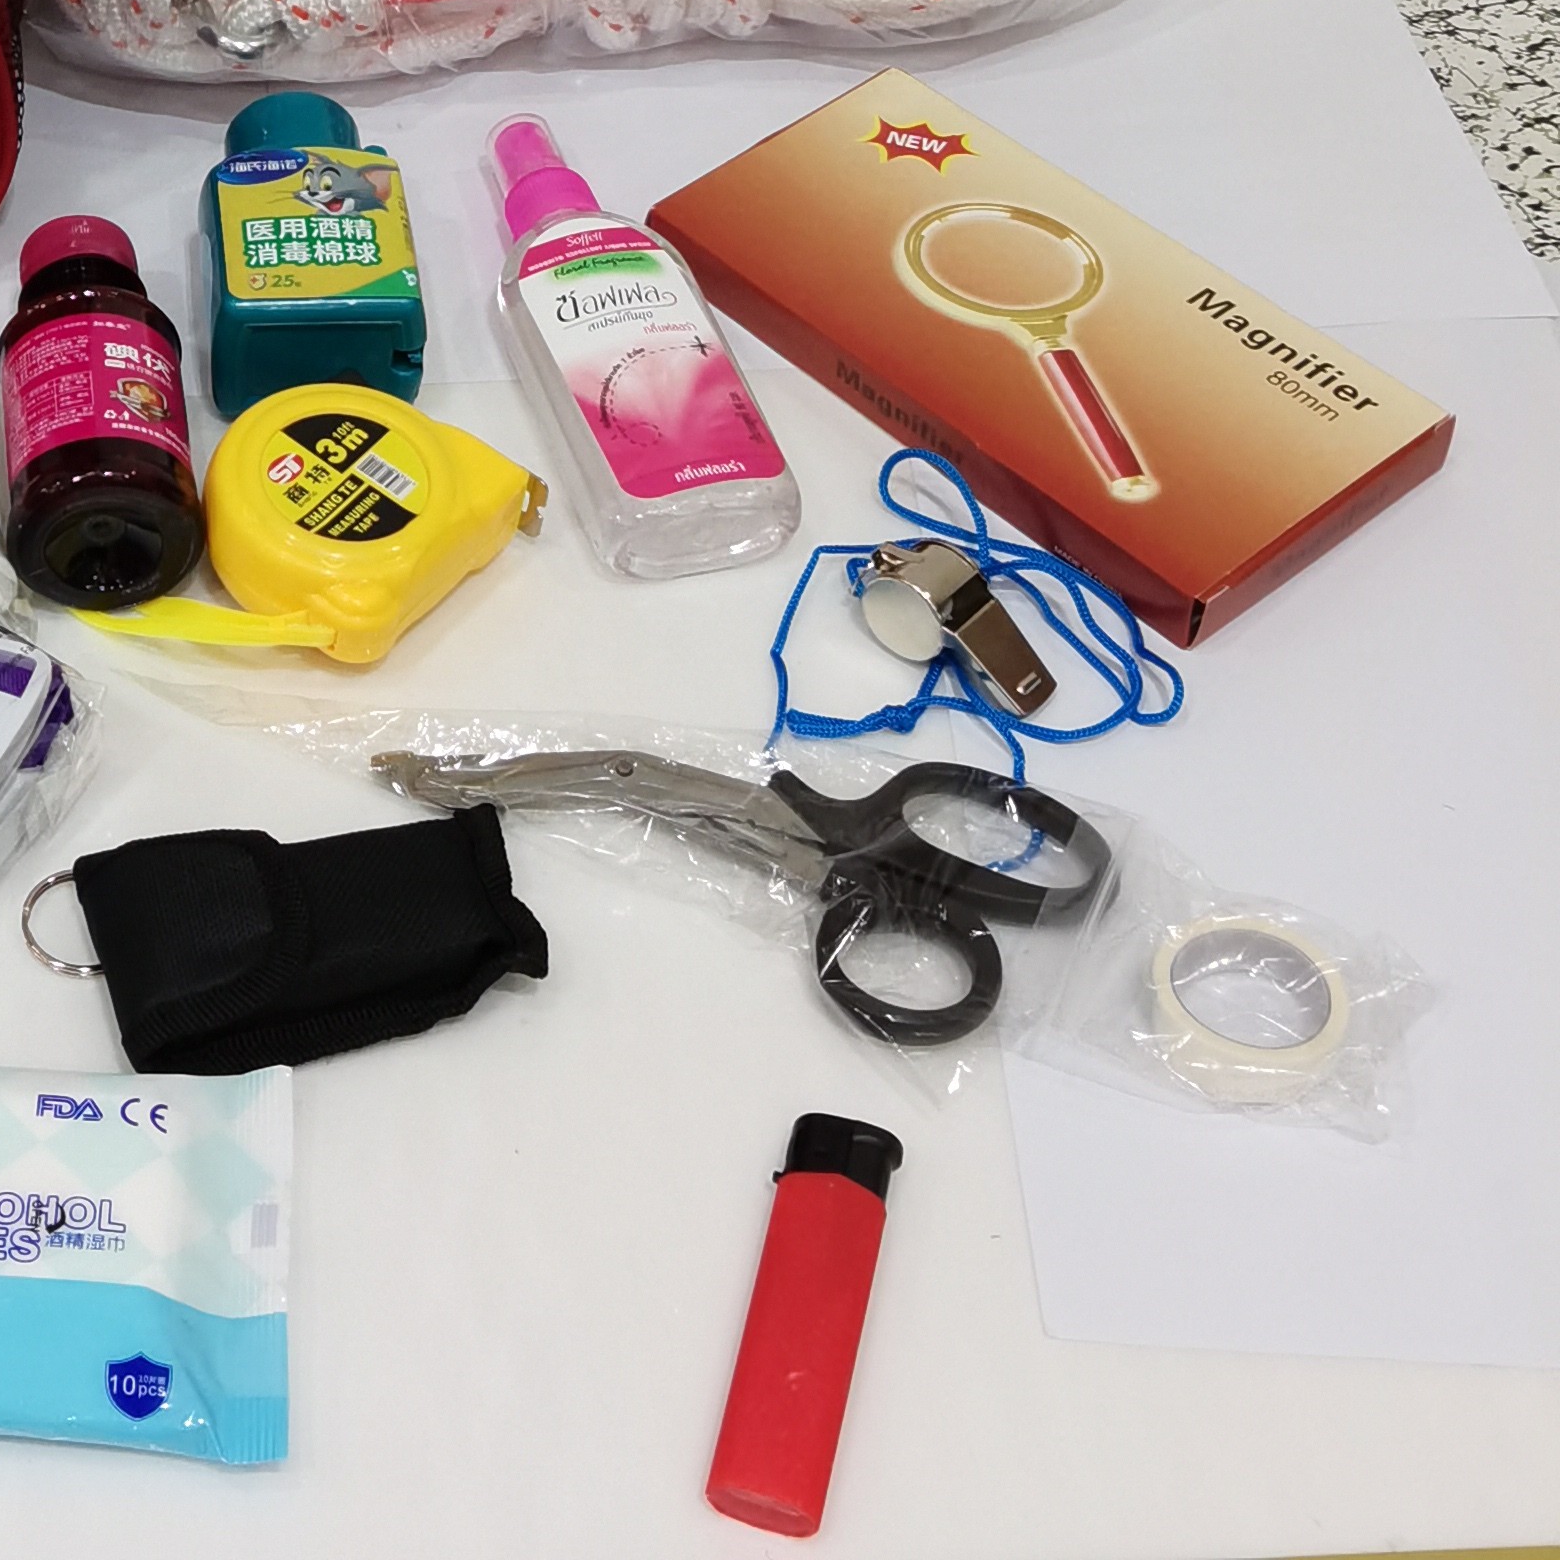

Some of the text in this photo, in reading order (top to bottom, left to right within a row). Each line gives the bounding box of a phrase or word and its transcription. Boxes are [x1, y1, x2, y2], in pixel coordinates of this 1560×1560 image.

[886, 131, 948, 154] NEW
[245, 217, 373, 241] 医用酒精
[247, 240, 378, 265] 消毒棉球
[554, 259, 590, 279] Floral
[1186, 288, 1380, 411] Magnifier
[1266, 370, 1340, 422] 80mm
[332, 421, 355, 439] 10ft
[304, 494, 343, 526] SHANG
[338, 480, 358, 495] TE
[328, 492, 380, 536] MEASURING
[353, 512, 380, 533] TAPE
[36, 1094, 103, 1121] FDA
[45, 1232, 125, 1252] 酒精湿巾
[110, 1374, 136, 1395] 10
[139, 1385, 166, 1398] pcs
